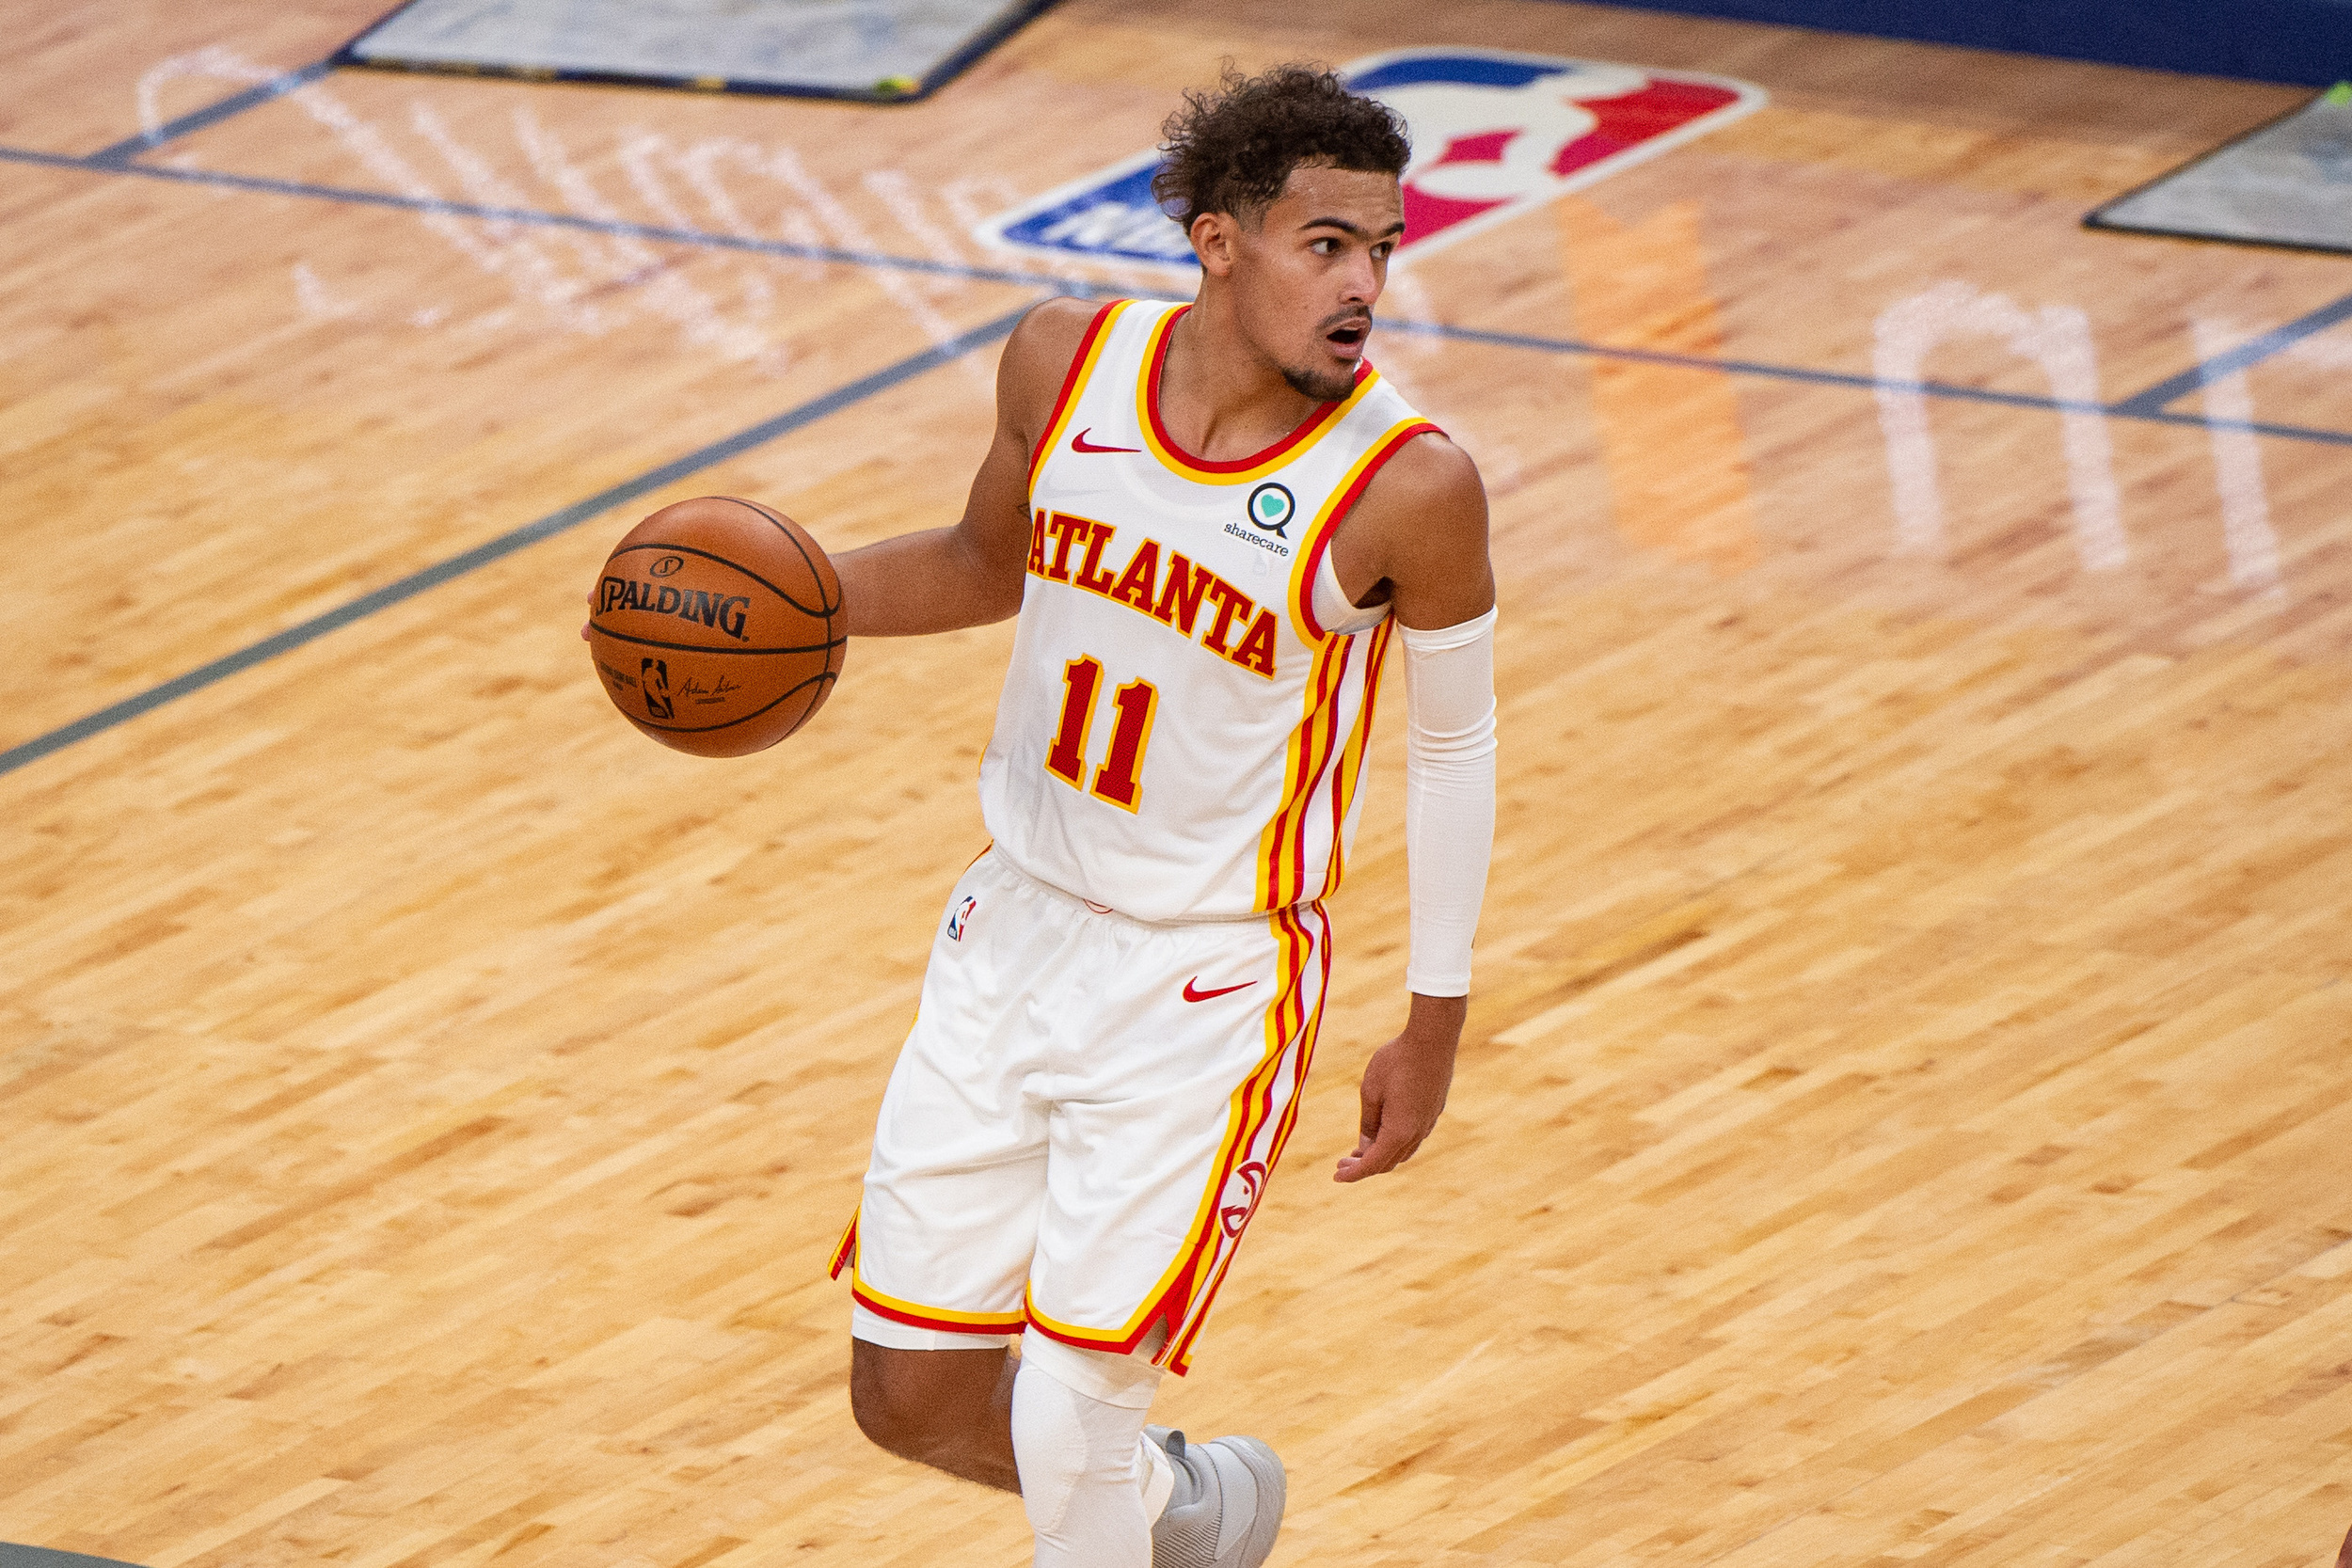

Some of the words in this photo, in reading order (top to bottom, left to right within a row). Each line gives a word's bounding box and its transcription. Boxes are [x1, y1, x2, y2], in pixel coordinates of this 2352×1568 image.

[1027, 507, 1278, 681] ATLANTA
[1223, 522, 1289, 557] sharecare
[596, 576, 751, 641] SPALDING
[1044, 653, 1159, 815] 11
